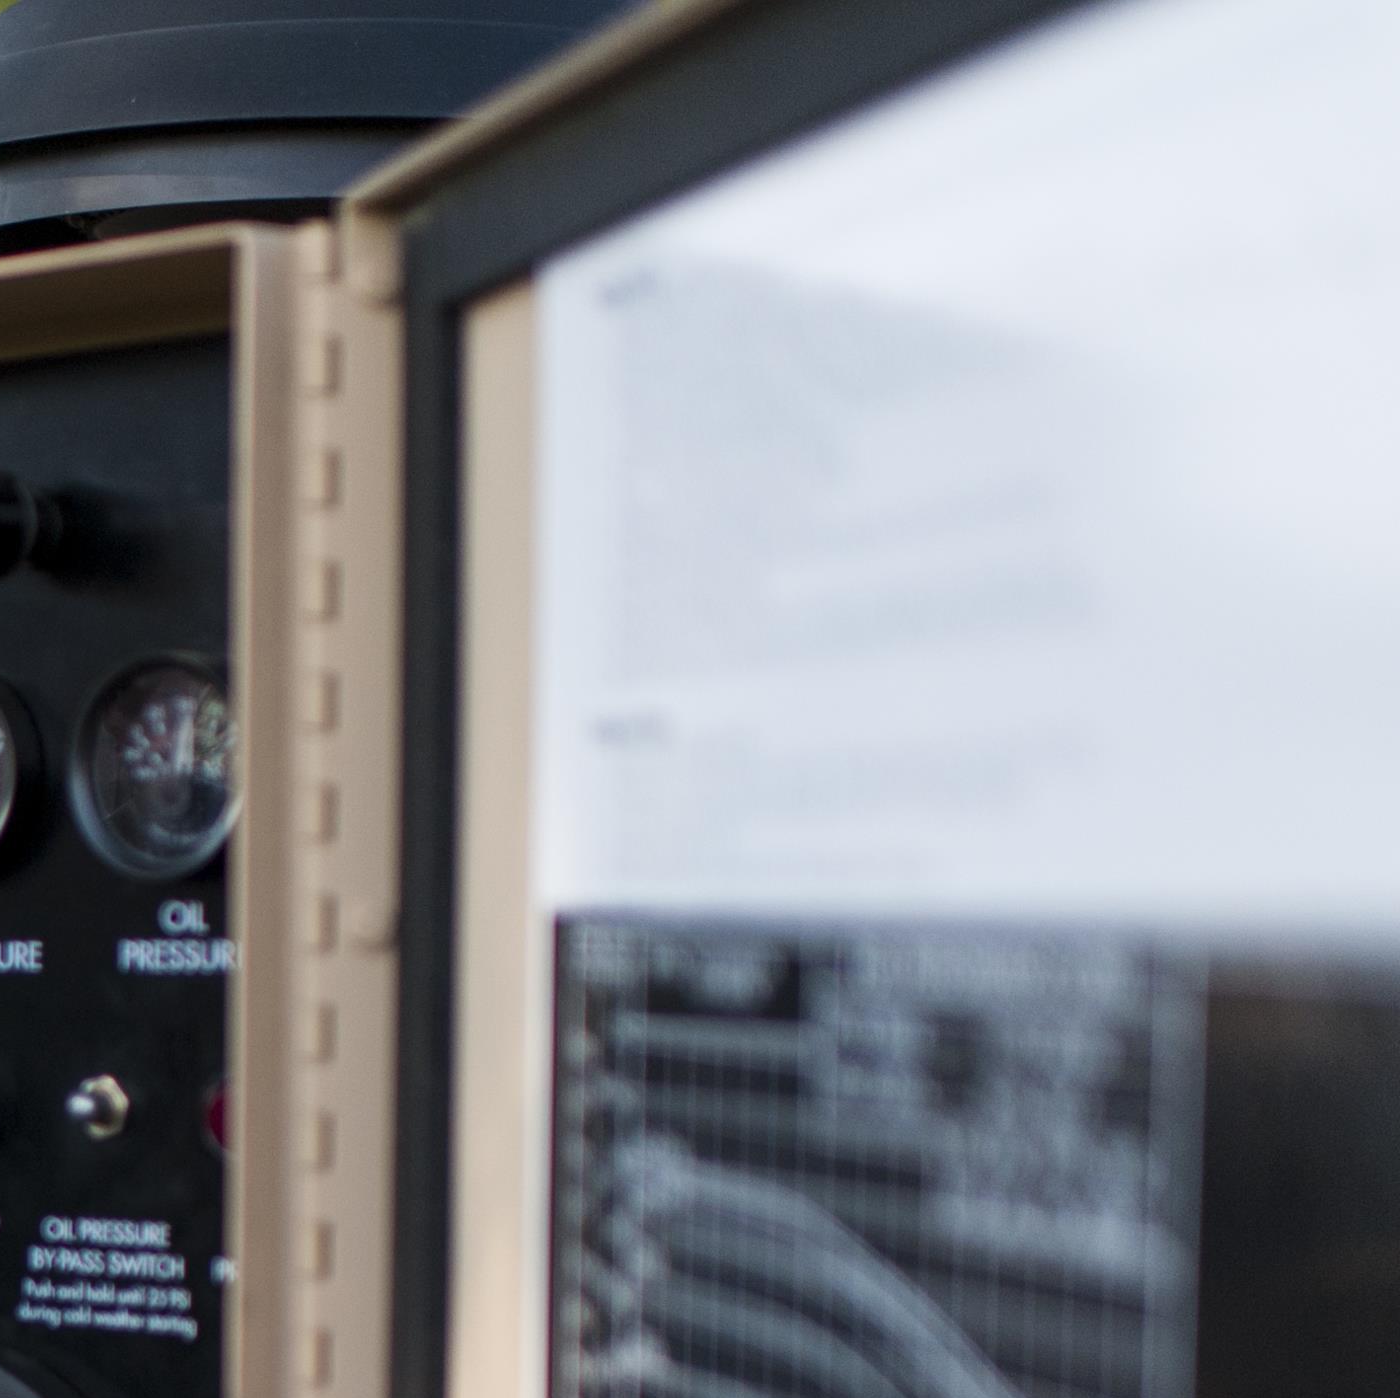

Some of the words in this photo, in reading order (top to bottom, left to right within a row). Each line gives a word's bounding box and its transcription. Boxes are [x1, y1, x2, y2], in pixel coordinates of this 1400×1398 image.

[157, 900, 209, 936] OIL
[40, 1215, 76, 1243] OIL
[76, 1217, 171, 1248] PRESSURE
[107, 1250, 185, 1280] SWITCH
[57, 1280, 83, 1300] and
